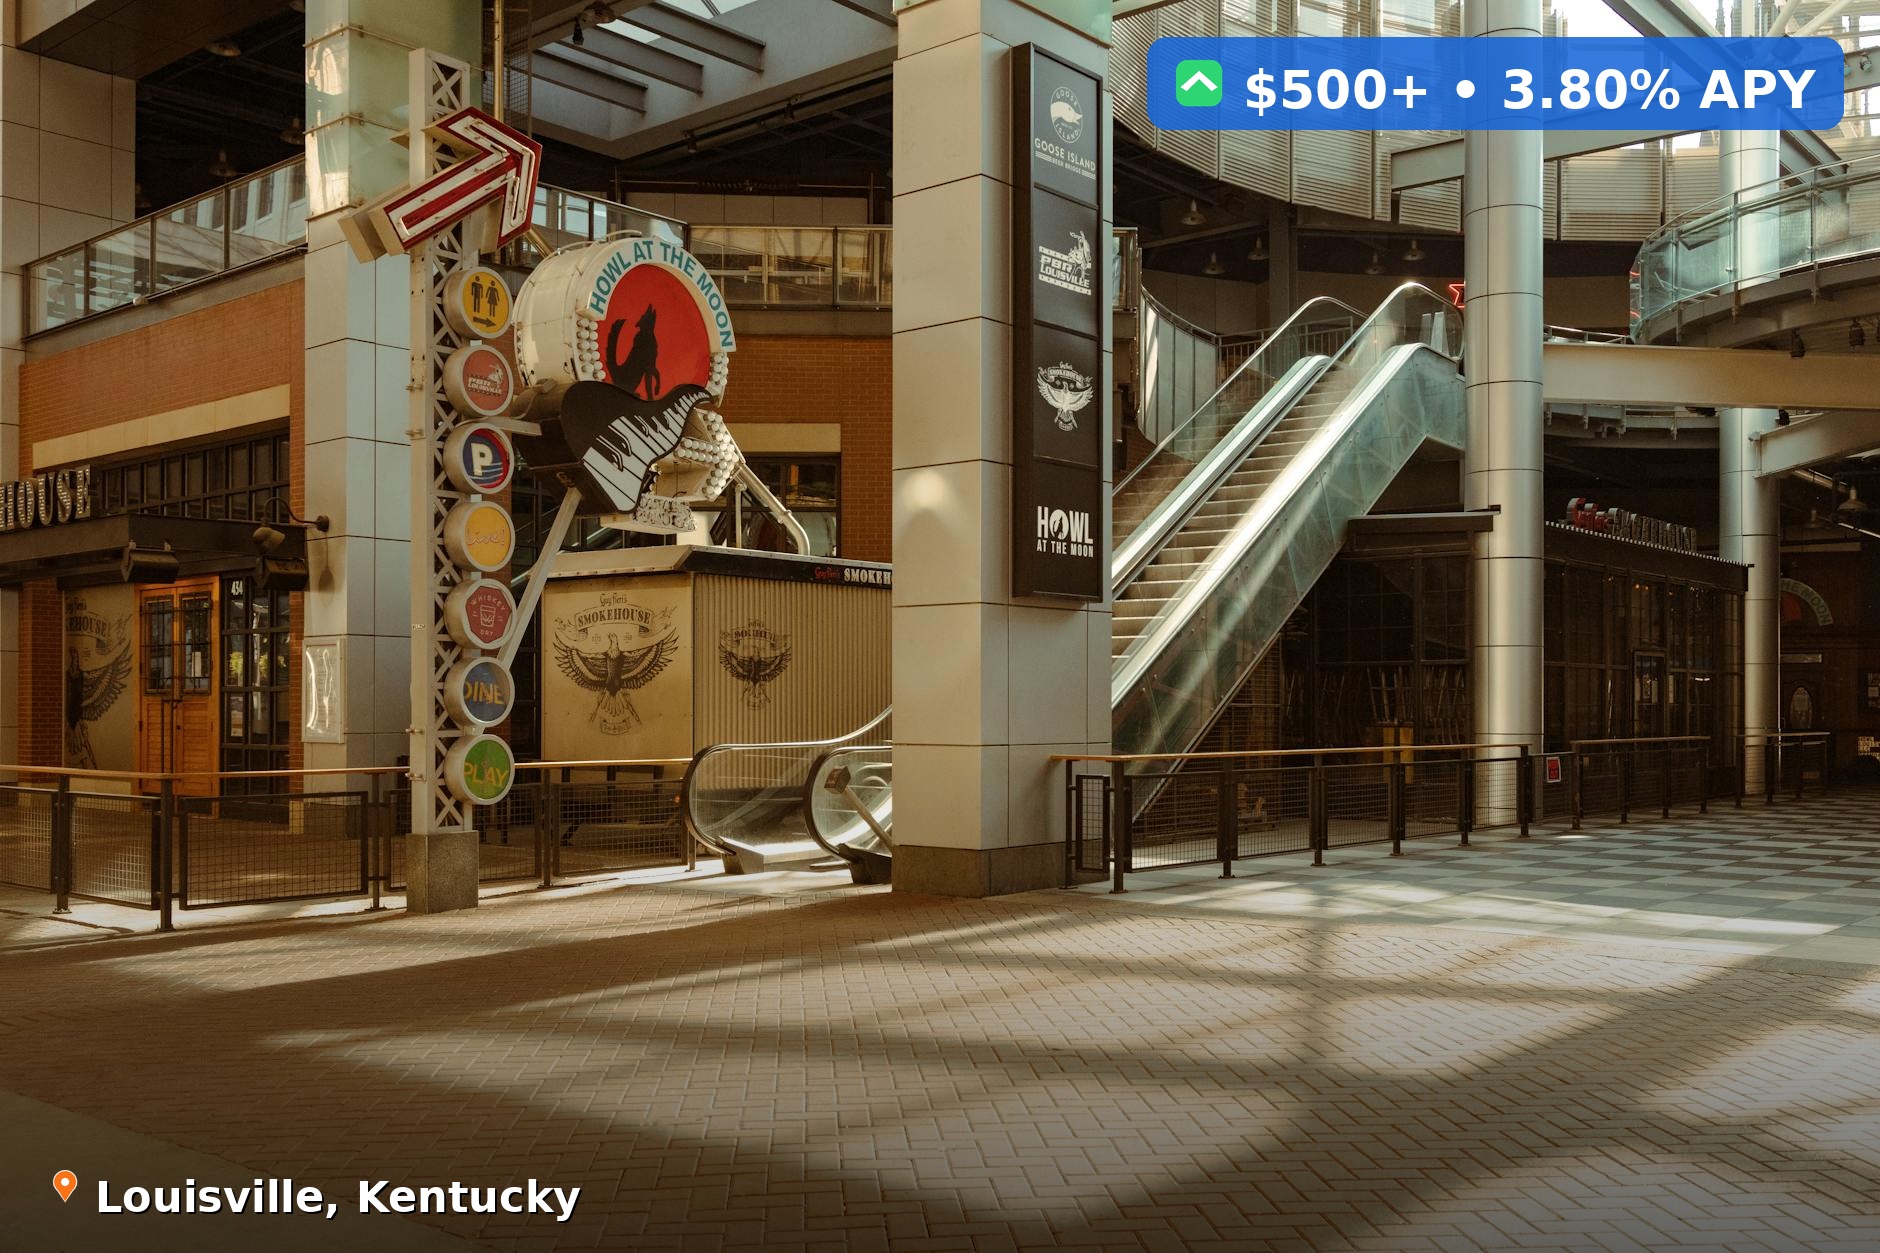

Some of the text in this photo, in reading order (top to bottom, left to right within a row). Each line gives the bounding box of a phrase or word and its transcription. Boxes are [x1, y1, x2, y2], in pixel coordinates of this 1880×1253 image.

[1034, 137, 1096, 171] GOOSE ISLAND
[1040, 254, 1074, 273] PBR
[1040, 263, 1090, 288] LOUISVILLE
[589, 240, 733, 348] HOWL AT THE MOON
[471, 442, 495, 477] P
[0, 463, 91, 531] HOUSE
[1037, 505, 1094, 545] HOWL
[1036, 539, 1094, 558] AT THE MOON
[844, 567, 893, 585] SMOKEH
[471, 595, 506, 612] WHISKEY
[577, 607, 651, 627] SMOKEHOUSE
